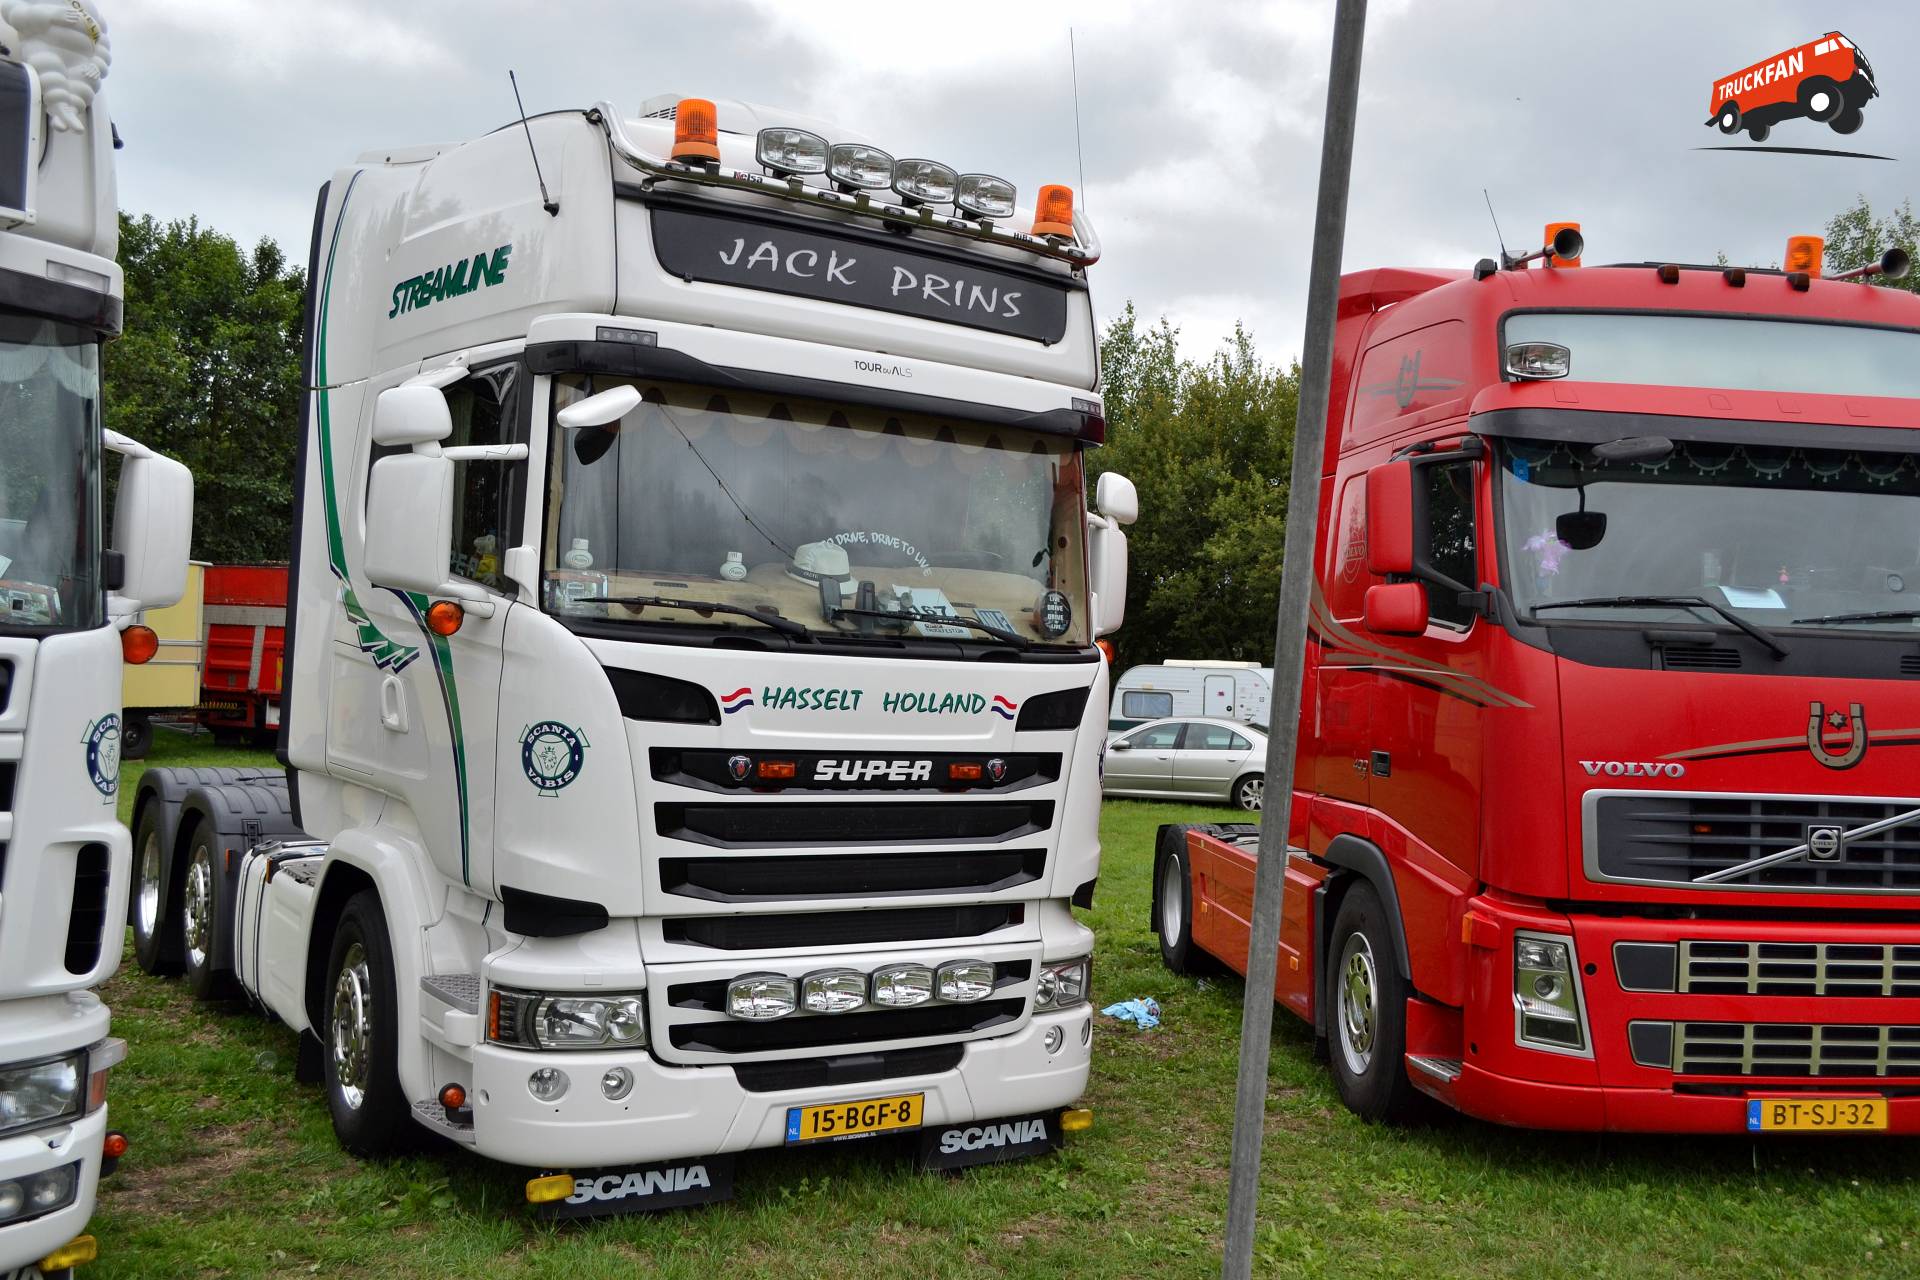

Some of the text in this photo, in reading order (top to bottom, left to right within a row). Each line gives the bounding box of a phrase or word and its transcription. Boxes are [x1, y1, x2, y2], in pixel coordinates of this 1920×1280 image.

[389, 244, 512, 320] STREAMLINE
[719, 238, 1022, 317] JACK PRINS
[854, 360, 882, 373] TOUR
[835, 531, 869, 546] DRIVE,
[871, 532, 900, 549] DRIVE
[900, 540, 915, 556] TO
[914, 551, 934, 577] LIVE
[762, 686, 986, 715] HASSELT HOLLAND
[527, 724, 576, 746] SCANIA
[527, 767, 575, 788] VABIS
[813, 760, 933, 782] SUPER
[1578, 760, 1686, 778] VOLVO
[812, 1100, 912, 1134] 15-BGF-8
[1749, 1103, 1875, 1125] NL BT-SJ-32
[939, 1118, 1048, 1154] SCANIA
[565, 1165, 711, 1204] SCANIA
